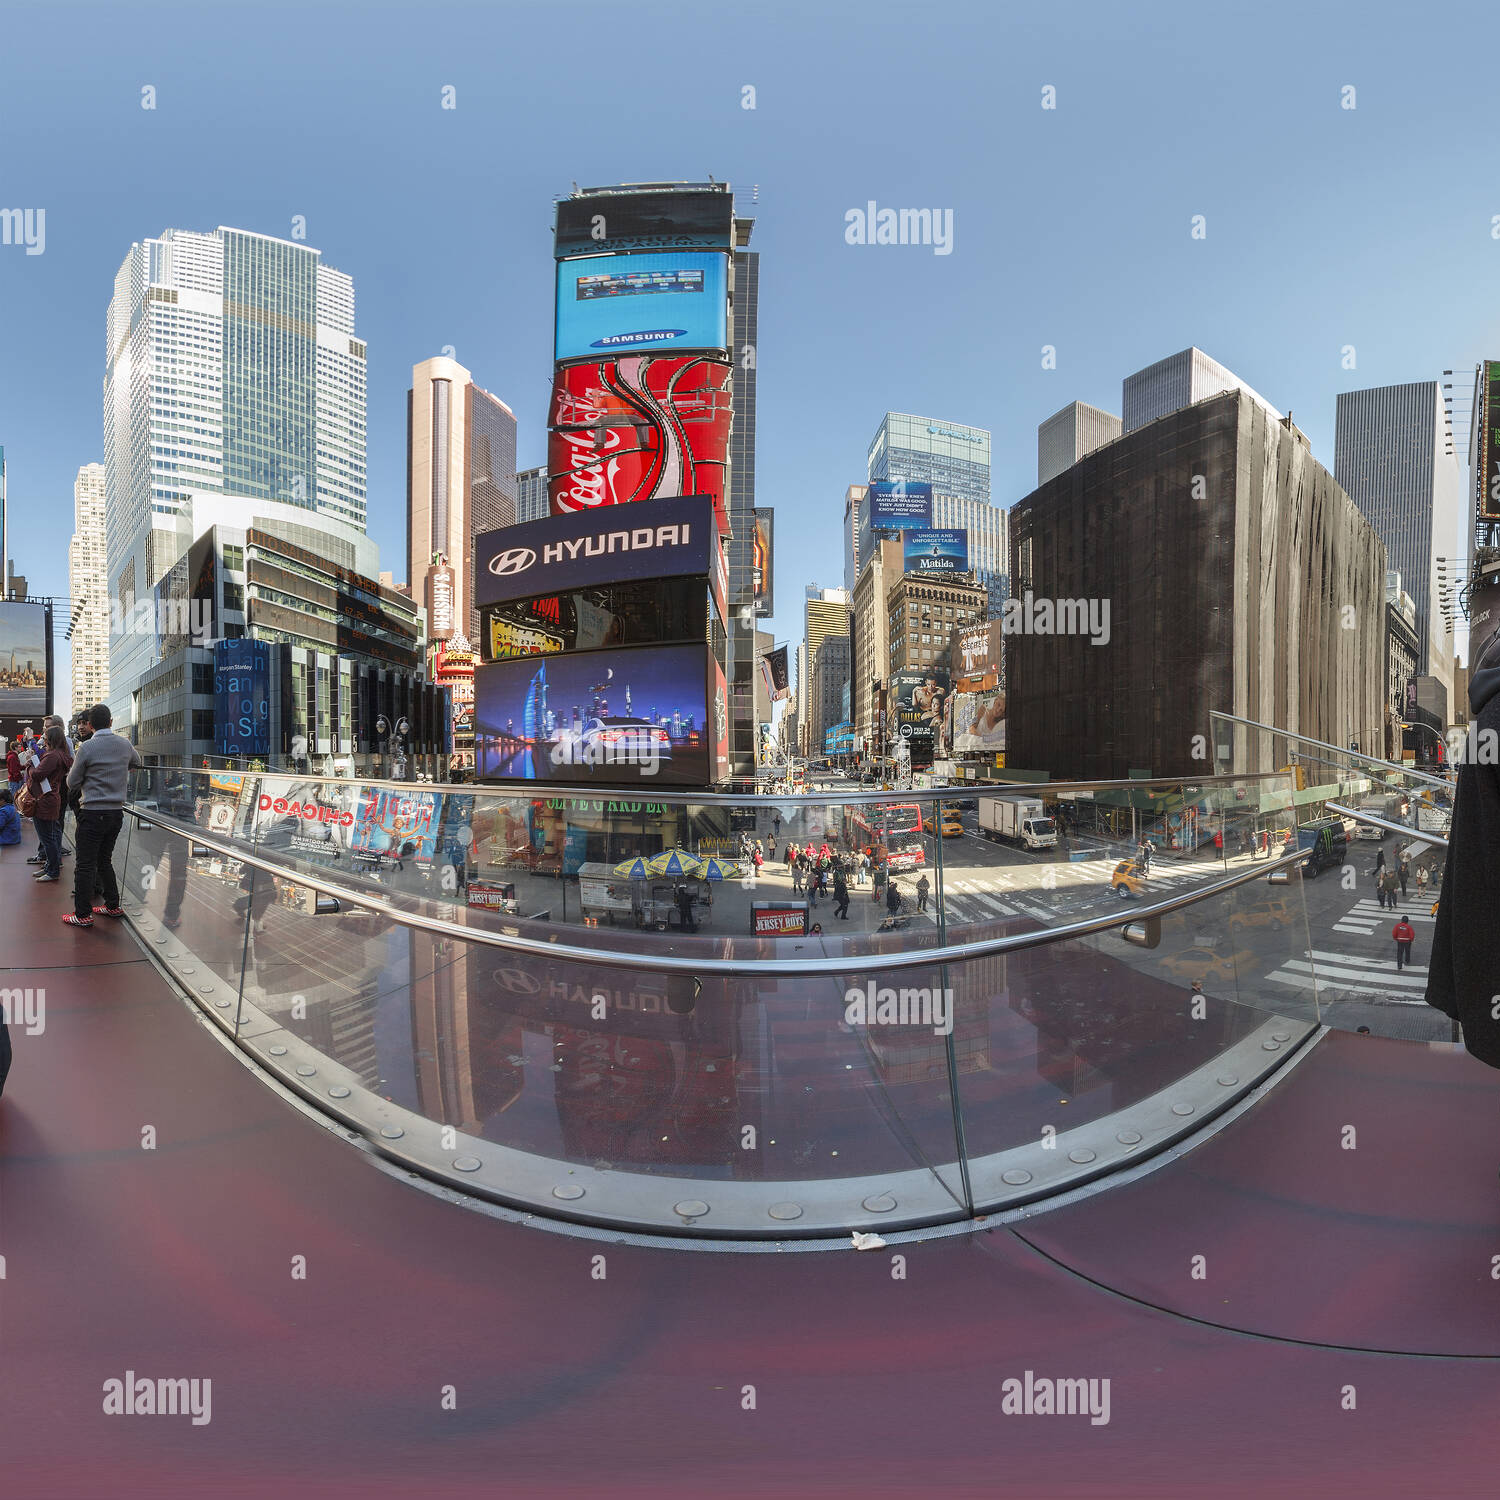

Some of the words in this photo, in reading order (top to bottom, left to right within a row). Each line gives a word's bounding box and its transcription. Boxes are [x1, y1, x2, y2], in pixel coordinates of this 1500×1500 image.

[594, 235, 692, 247] XINHUA
[602, 332, 675, 344] SAMSUNG
[543, 524, 690, 565] HYUNDAI
[920, 558, 954, 569] Matilda
[433, 573, 450, 631] HERSHEY'S
[755, 918, 783, 932] JERSEY
[784, 915, 804, 928] BOYS
